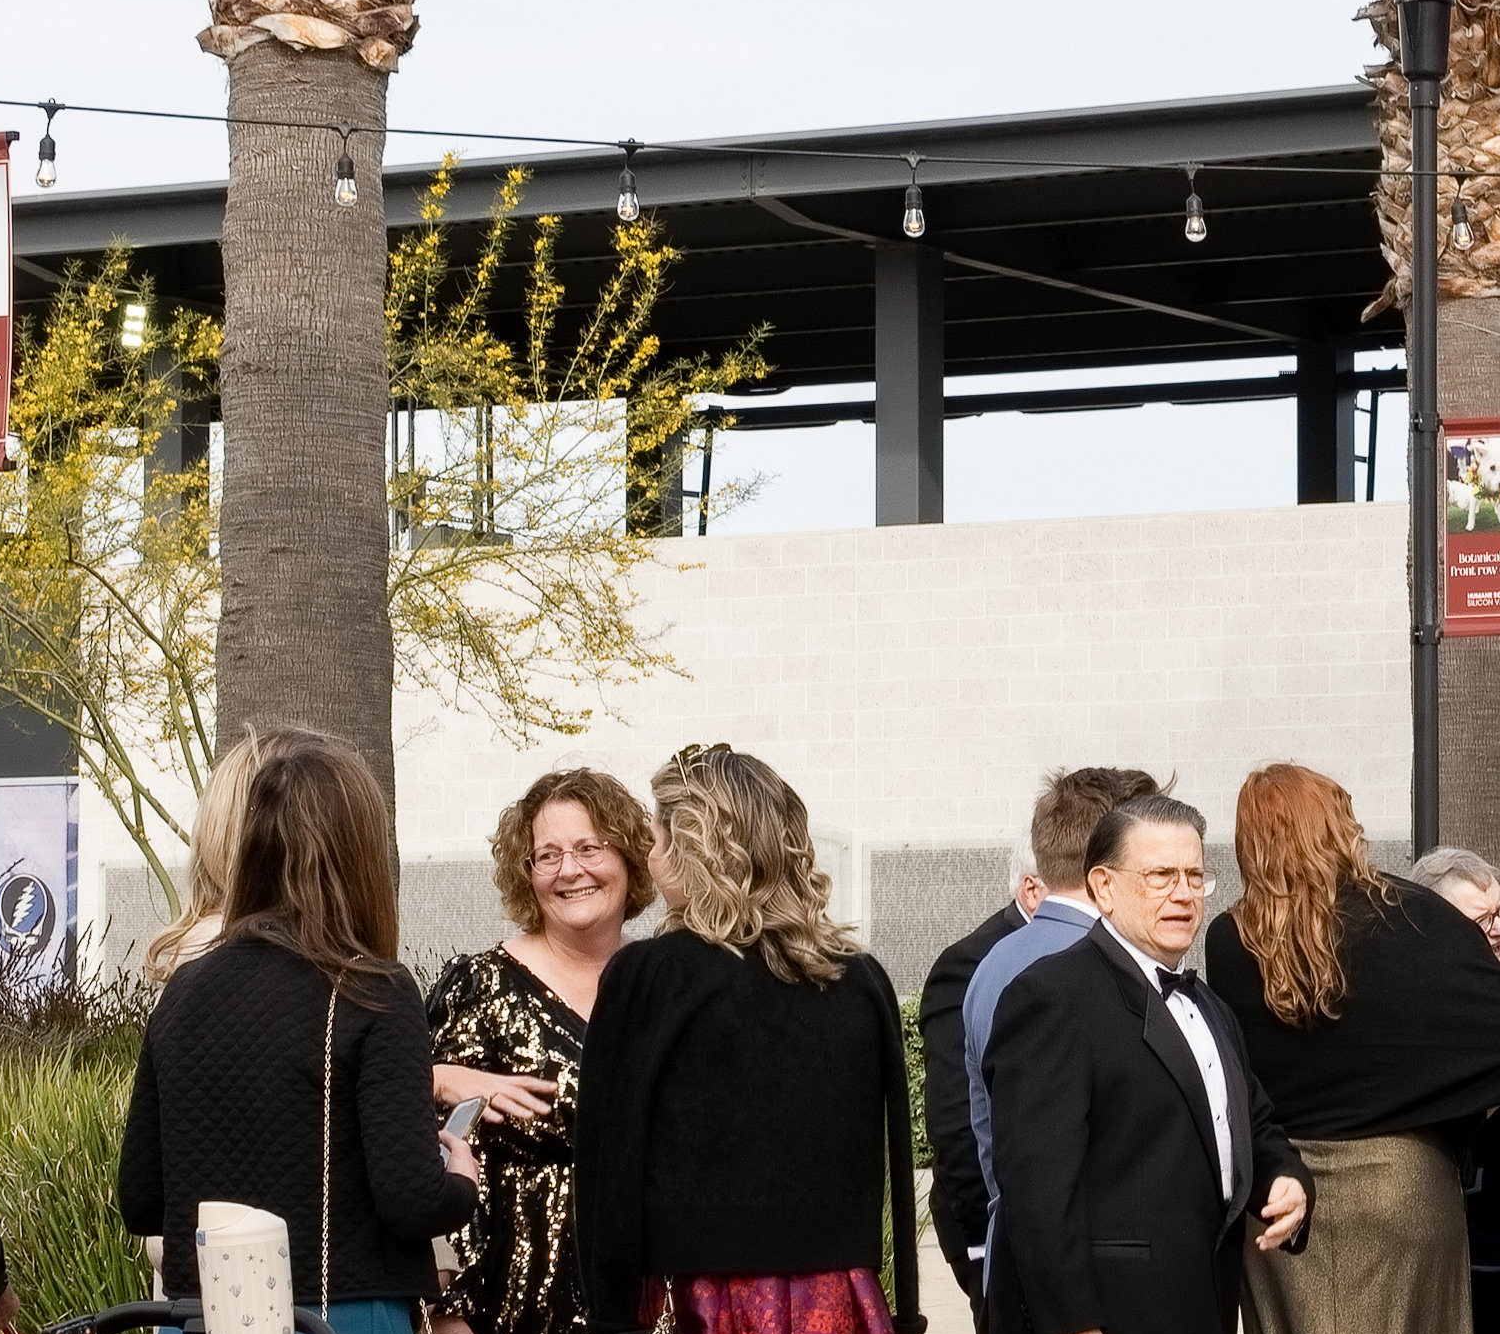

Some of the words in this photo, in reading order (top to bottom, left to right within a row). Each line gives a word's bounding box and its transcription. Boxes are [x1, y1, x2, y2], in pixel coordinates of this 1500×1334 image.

[1450, 565, 1476, 577] front
[1477, 566, 1498, 576] row
[1467, 599, 1493, 607] SILICON
